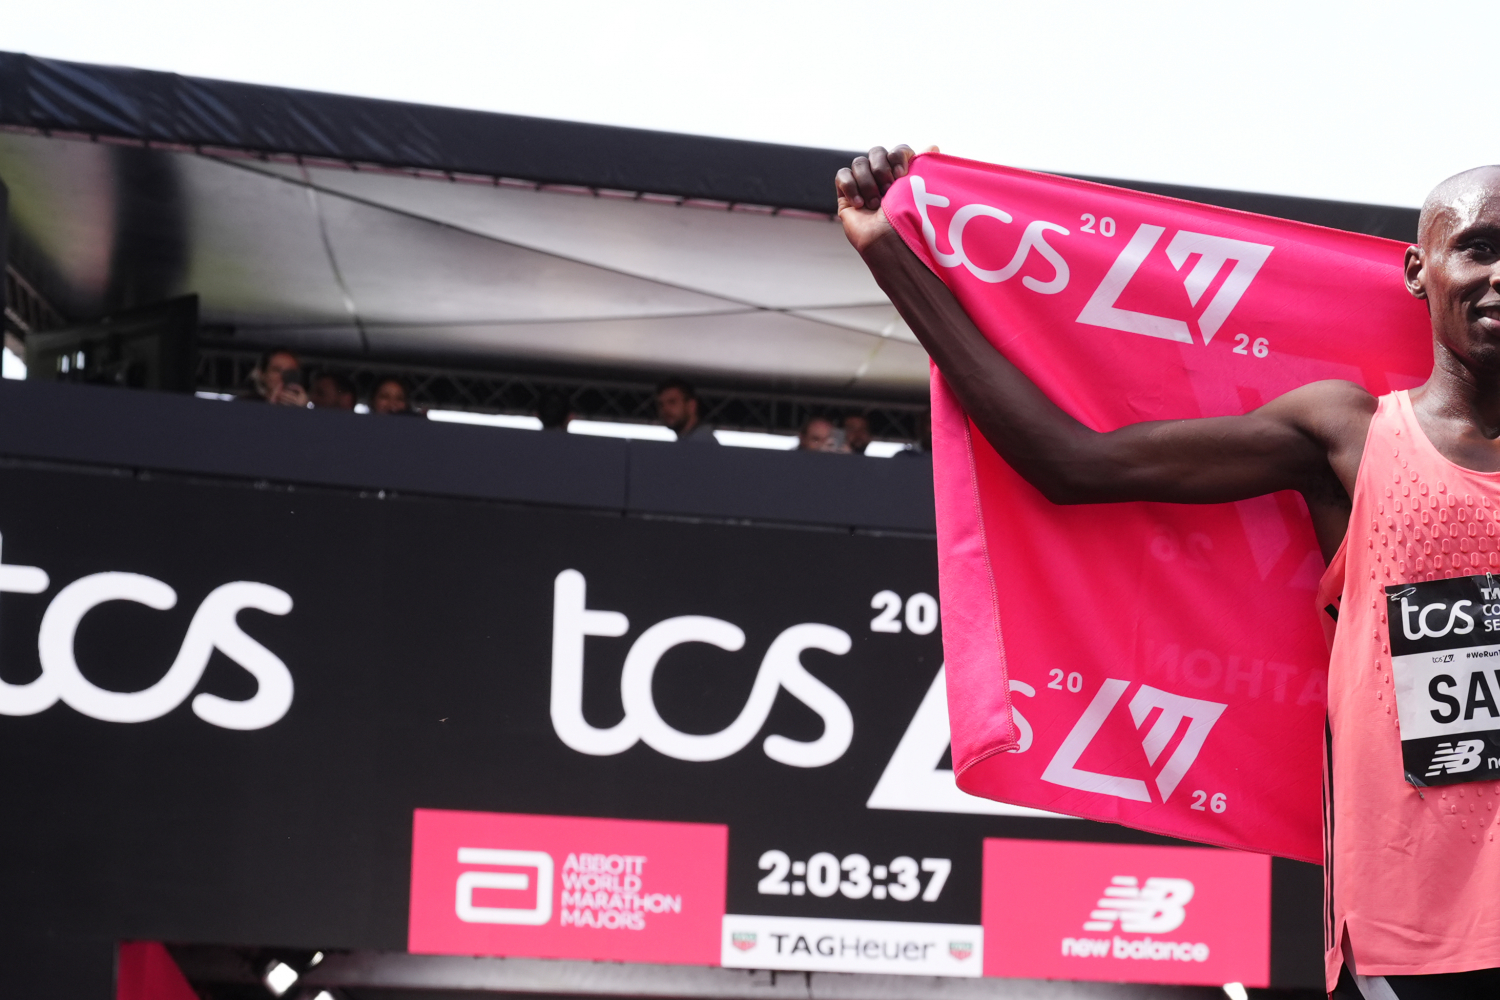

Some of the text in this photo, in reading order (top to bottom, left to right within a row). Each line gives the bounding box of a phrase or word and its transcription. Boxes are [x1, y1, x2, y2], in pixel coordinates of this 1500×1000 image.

[910, 175, 1070, 295] tcs
[1080, 213, 1116, 237] 20
[1232, 333, 1269, 357] 26
[1401, 597, 1475, 641] tcs
[550, 568, 854, 768] tcs
[870, 590, 938, 635] 20
[1047, 668, 1083, 693] 20
[1190, 789, 1227, 813] 26
[562, 853, 648, 876] ABBOTT
[758, 850, 952, 902] 2:03:37
[562, 873, 642, 893] WORLD
[560, 910, 645, 930] MAJORS
[561, 891, 682, 914] MARATHON
[1062, 936, 1209, 962] new balance
